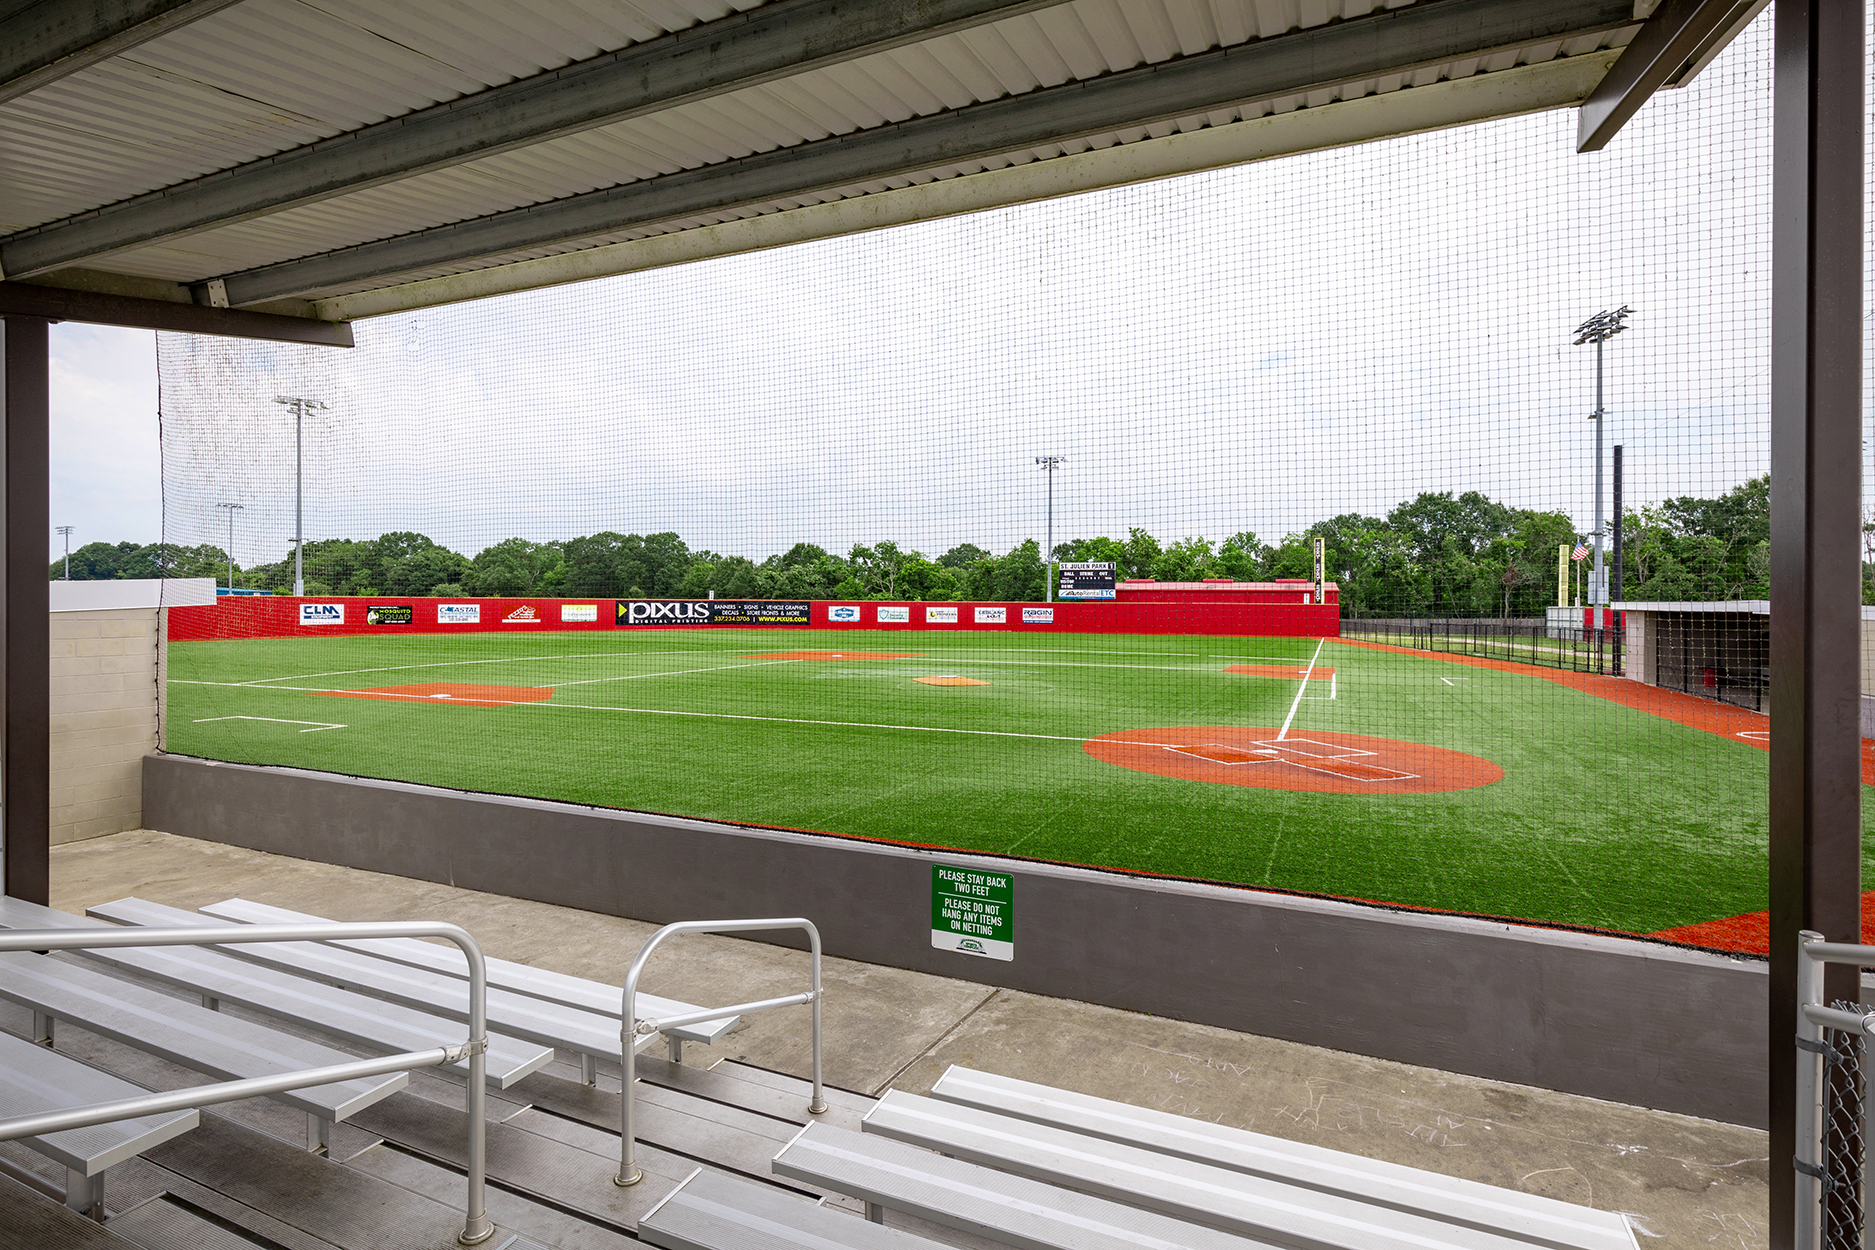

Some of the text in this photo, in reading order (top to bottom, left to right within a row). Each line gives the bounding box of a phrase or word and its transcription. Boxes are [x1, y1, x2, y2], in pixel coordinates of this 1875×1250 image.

[304, 606, 340, 614] CLM
[939, 870, 1006, 888] PLEASE STAY BACK
[954, 882, 990, 896] TWO FEET
[945, 898, 1000, 915] PLEASE DO NOT
[942, 908, 1002, 926] HANG ANY ITEMS
[951, 920, 992, 935] ON NETTING
